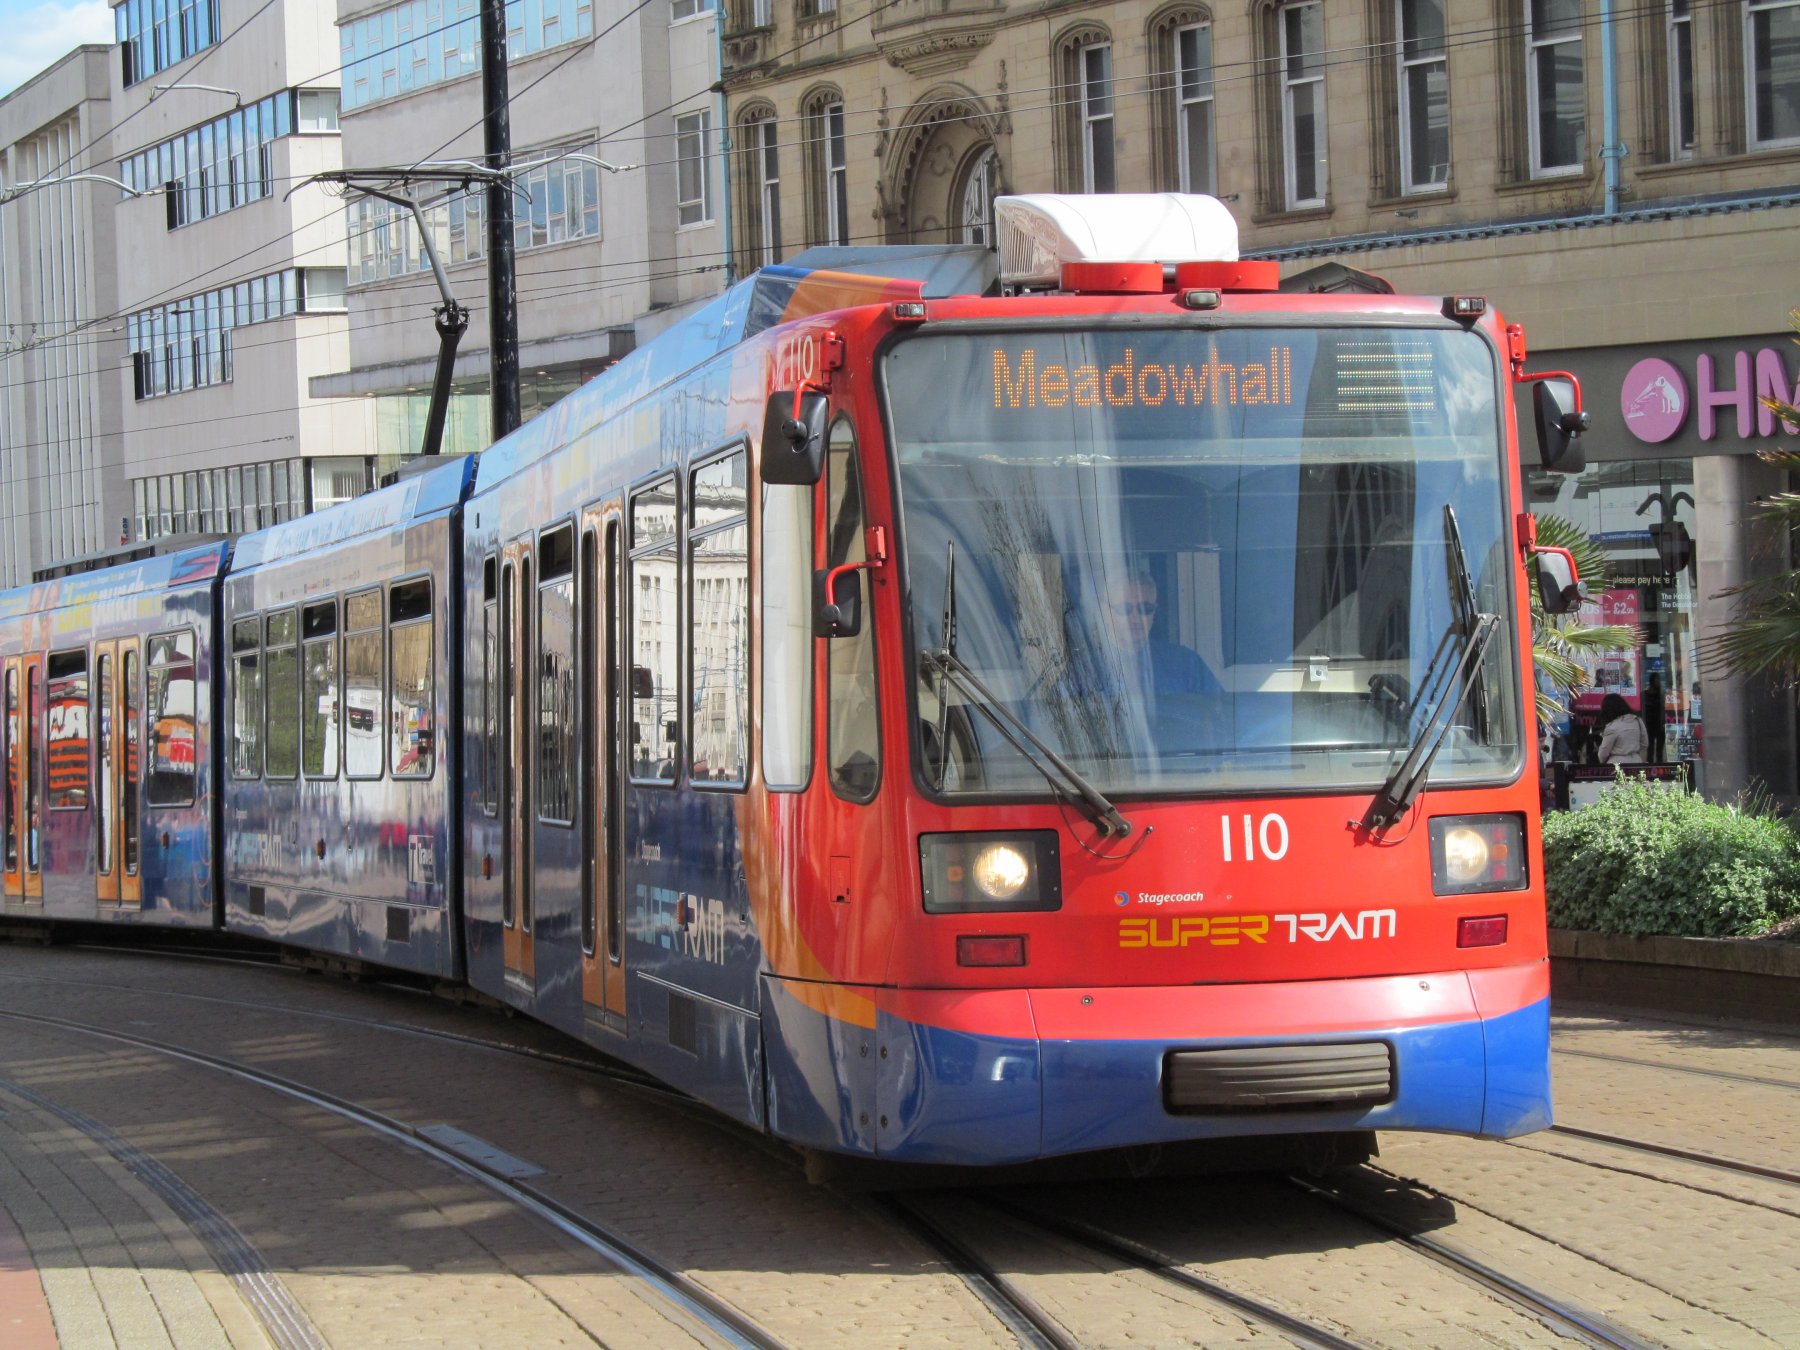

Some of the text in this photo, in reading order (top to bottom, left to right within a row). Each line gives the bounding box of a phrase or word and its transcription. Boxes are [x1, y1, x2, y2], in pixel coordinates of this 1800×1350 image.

[790, 335, 813, 381] 110
[993, 347, 1291, 407] Meadowhall
[1612, 575, 1636, 587] please
[1637, 577, 1651, 586] pay
[1221, 812, 1289, 861] 110
[1137, 891, 1204, 905] Stagecoach
